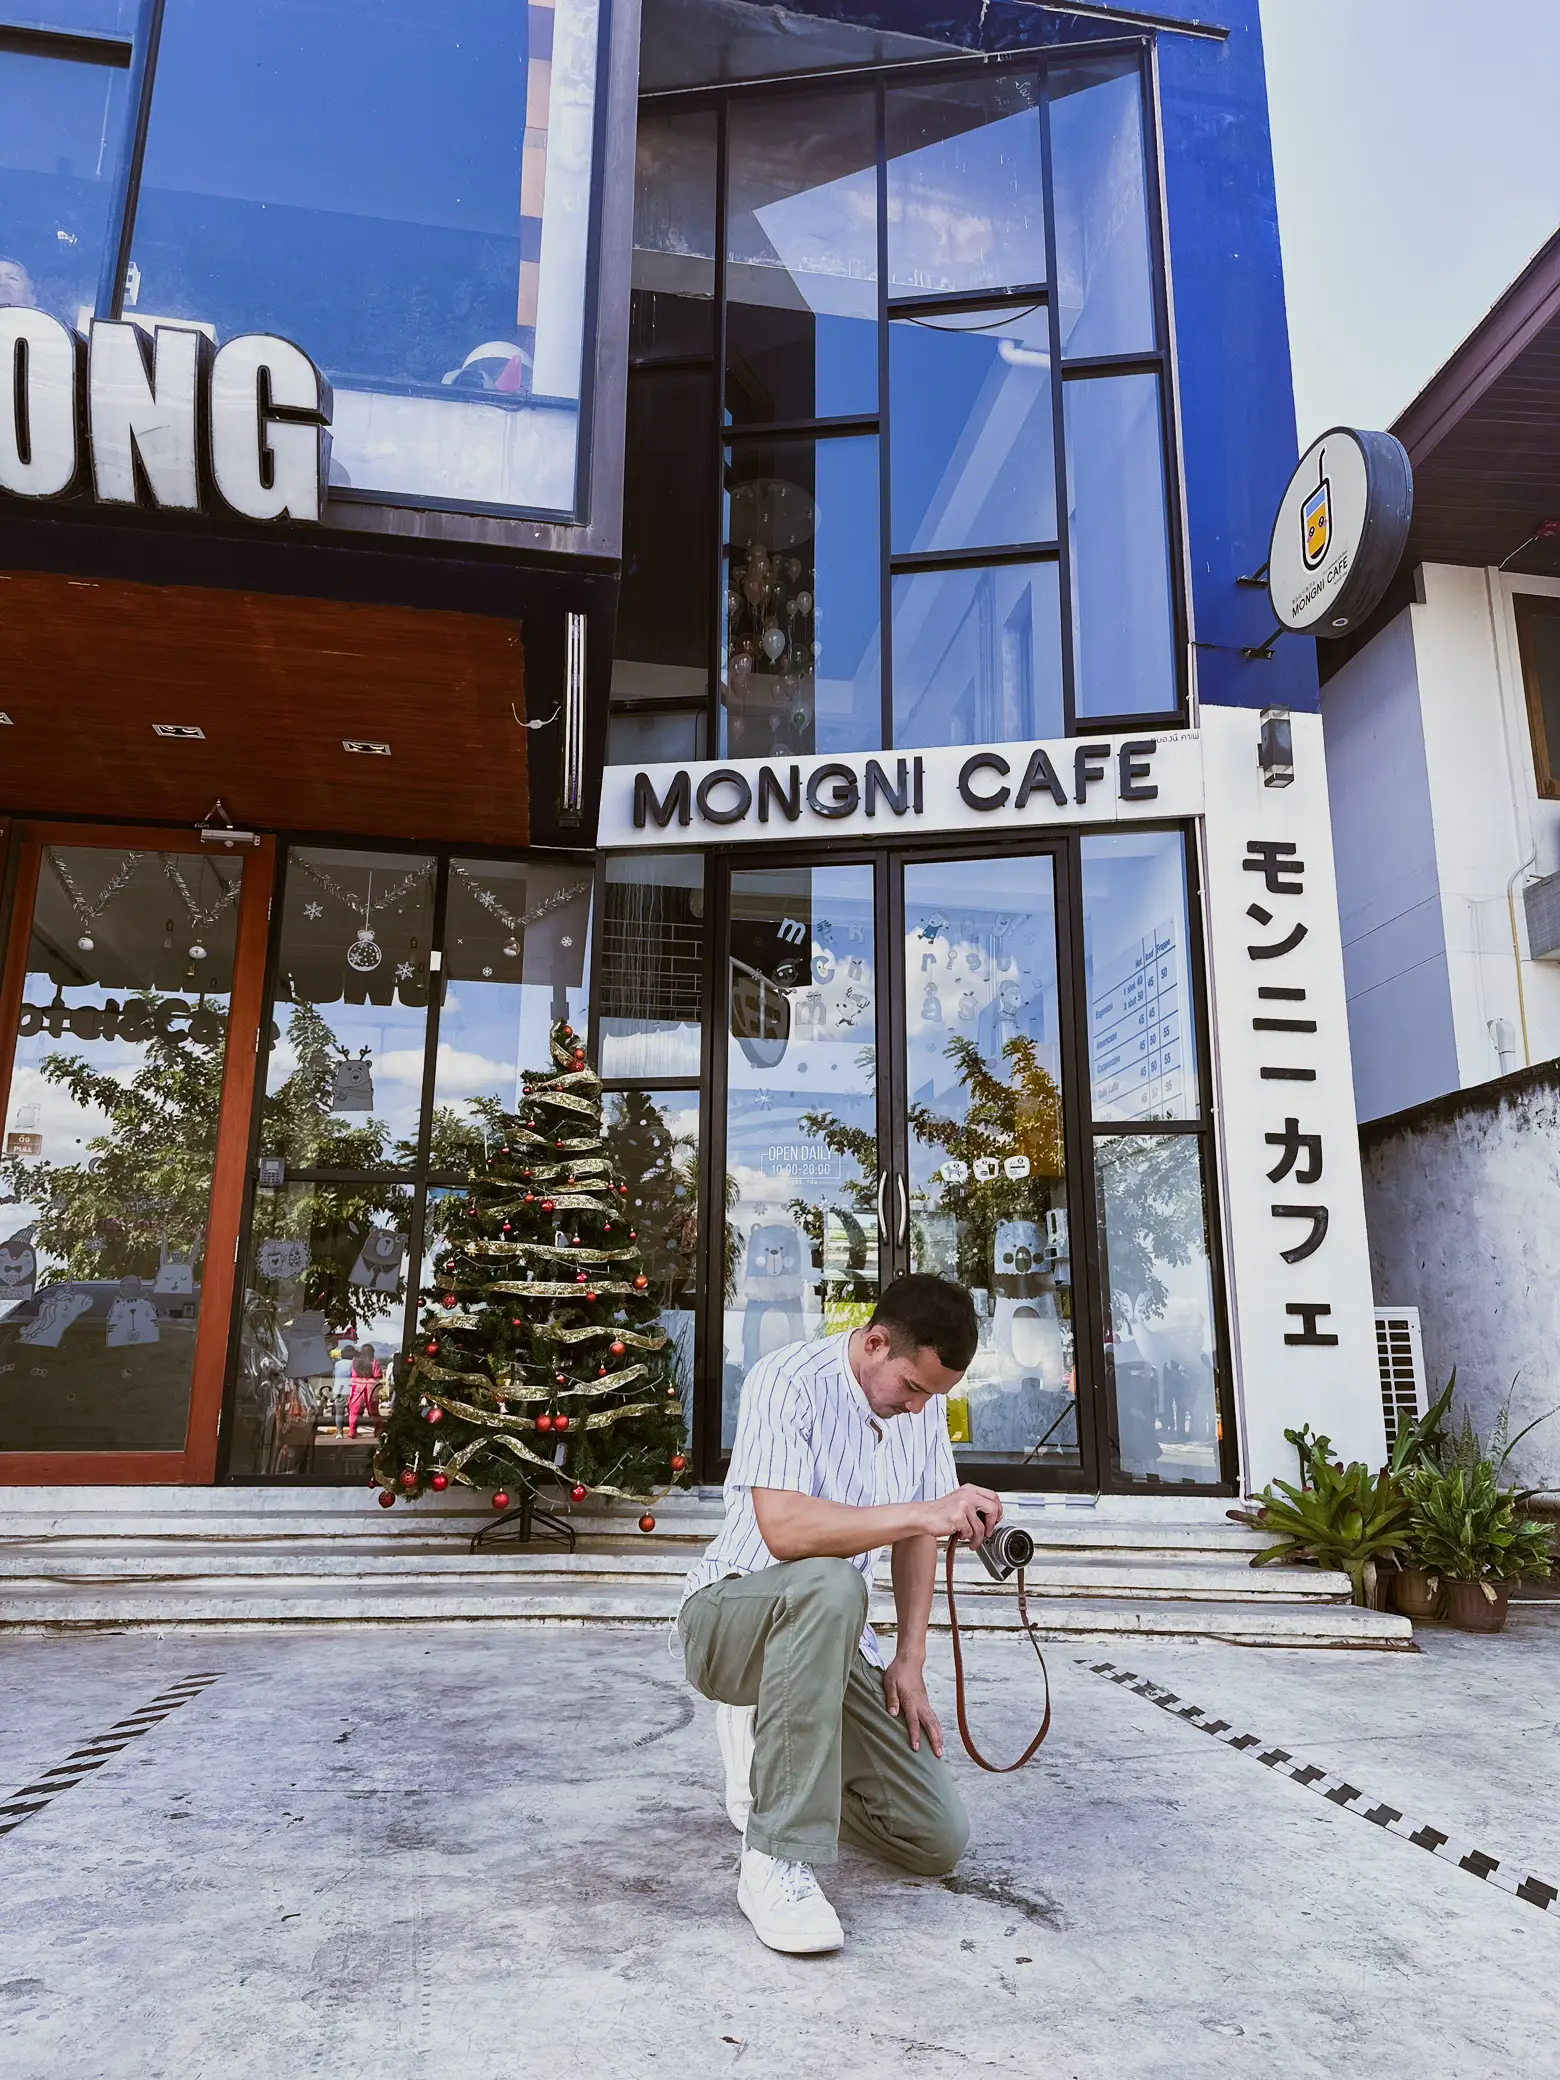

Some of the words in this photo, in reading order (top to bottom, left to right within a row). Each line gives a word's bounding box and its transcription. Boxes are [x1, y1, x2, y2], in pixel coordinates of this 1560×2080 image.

[1292, 578, 1325, 618] MONGNI
[1327, 555, 1348, 584] CAFE
[633, 756, 924, 829] MONGNI
[958, 740, 1159, 811] CAFE
[1147, 975, 1154, 988] 45
[1160, 966, 1168, 980] 50
[1137, 990, 1144, 1002] 50
[1138, 1012, 1145, 1025] 45
[1148, 1006, 1156, 1019] 45
[1150, 1033, 1157, 1046] 50
[1163, 1024, 1170, 1038] 55
[1140, 1065, 1147, 1078] 45
[1150, 1059, 1158, 1073] 50
[1164, 1052, 1171, 1065] 55
[1165, 1079, 1172, 1092] 55
[13, 1145, 33, 1153] PULL
[768, 1146, 797, 1161] OPEN
[801, 1145, 833, 1161] DAILY
